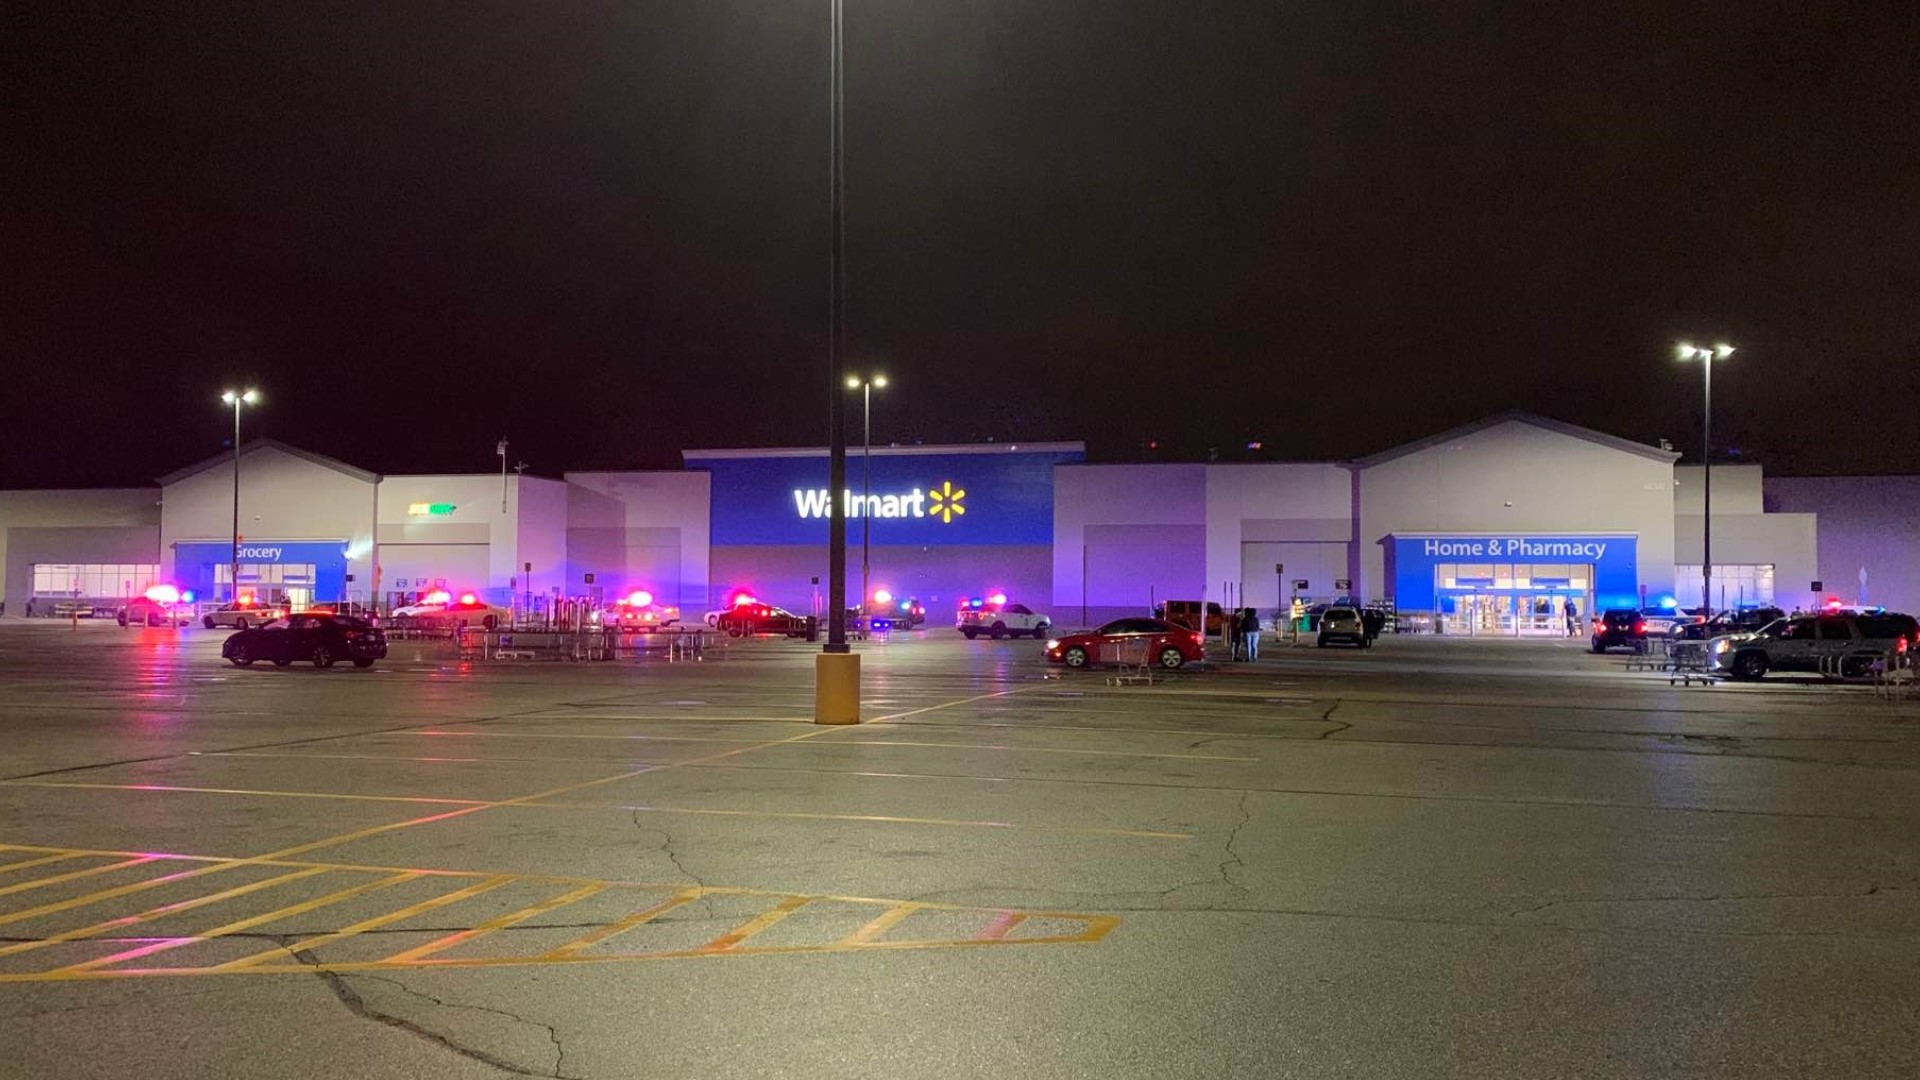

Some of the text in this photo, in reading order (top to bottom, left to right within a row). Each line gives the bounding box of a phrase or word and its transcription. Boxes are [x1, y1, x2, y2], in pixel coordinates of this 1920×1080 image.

[1424, 539, 1606, 560] Home & Pharmacy
